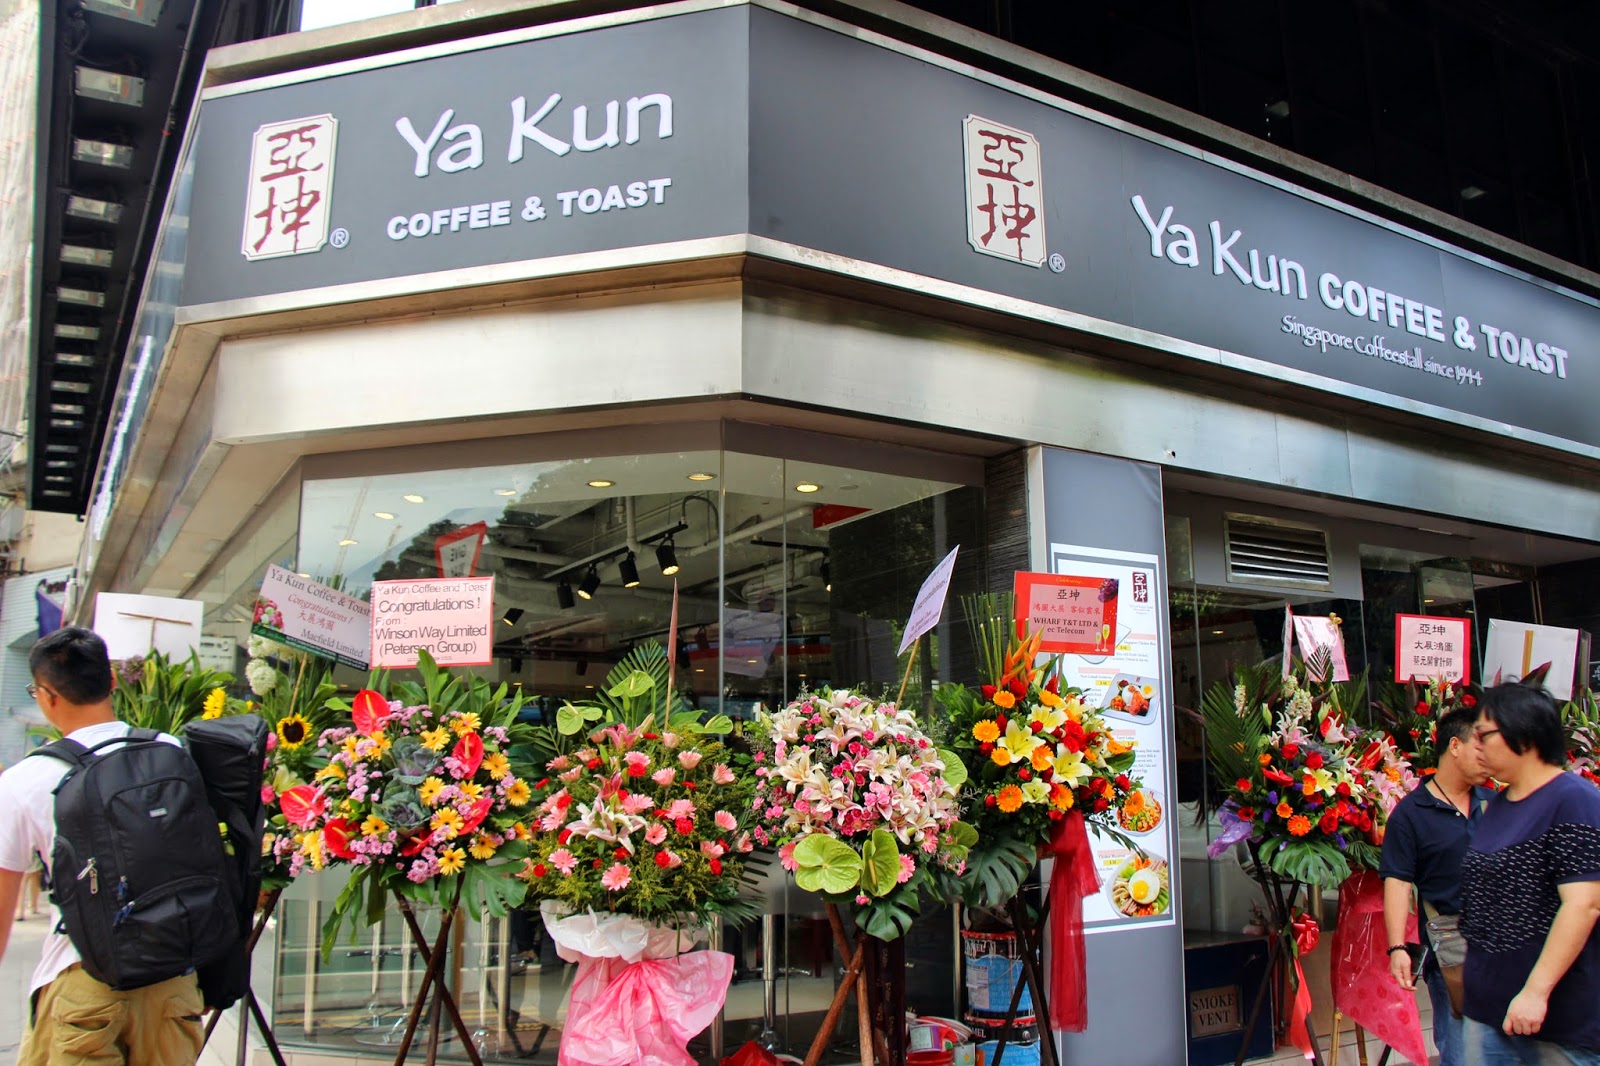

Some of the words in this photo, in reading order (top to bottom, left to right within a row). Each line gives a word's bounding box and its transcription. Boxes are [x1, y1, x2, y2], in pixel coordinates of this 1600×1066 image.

[394, 108, 484, 178] Ya
[506, 92, 673, 164] Kun
[252, 123, 325, 254] 亞坤
[976, 129, 1038, 262] 亞坤
[386, 200, 511, 241] COFFEE
[520, 195, 547, 223] &
[556, 178, 673, 217] TOAST
[1131, 194, 1200, 268] Ya
[1209, 220, 1308, 300] Kun
[1318, 272, 1446, 343] COFFEE
[1453, 316, 1477, 351] &
[1480, 323, 1568, 379] TOAST
[1281, 315, 1353, 353] Singapore
[1353, 335, 1423, 370] Coffeestall
[1424, 355, 1455, 380] since
[1454, 365, 1483, 386] 1944
[270, 568, 283, 582] Ya
[285, 575, 305, 589] Kun
[307, 585, 337, 603] Coffee
[337, 597, 345, 606] &
[347, 599, 371, 617] Toast
[377, 586, 390, 595] Ya
[391, 585, 410, 595] Kun
[411, 583, 442, 593] Coffee
[442, 583, 460, 593] and
[463, 582, 488, 592] Toast
[1056, 589, 1081, 601] 亞坤
[1033, 617, 1061, 626] WHARF
[1062, 618, 1077, 627] T&T
[1078, 619, 1092, 627] LTD
[1092, 620, 1099, 628] &
[1056, 627, 1086, 635] Telecom
[1417, 623, 1446, 636] 亞坤
[375, 627, 418, 640] Winson
[418, 626, 447, 641] Way
[446, 624, 488, 638] Limited
[300, 628, 335, 649] Macfield
[335, 640, 364, 658] Limited
[436, 640, 478, 655] Group)
[1192, 993, 1235, 1012] SMOKE
[1199, 1010, 1231, 1027] VENT
